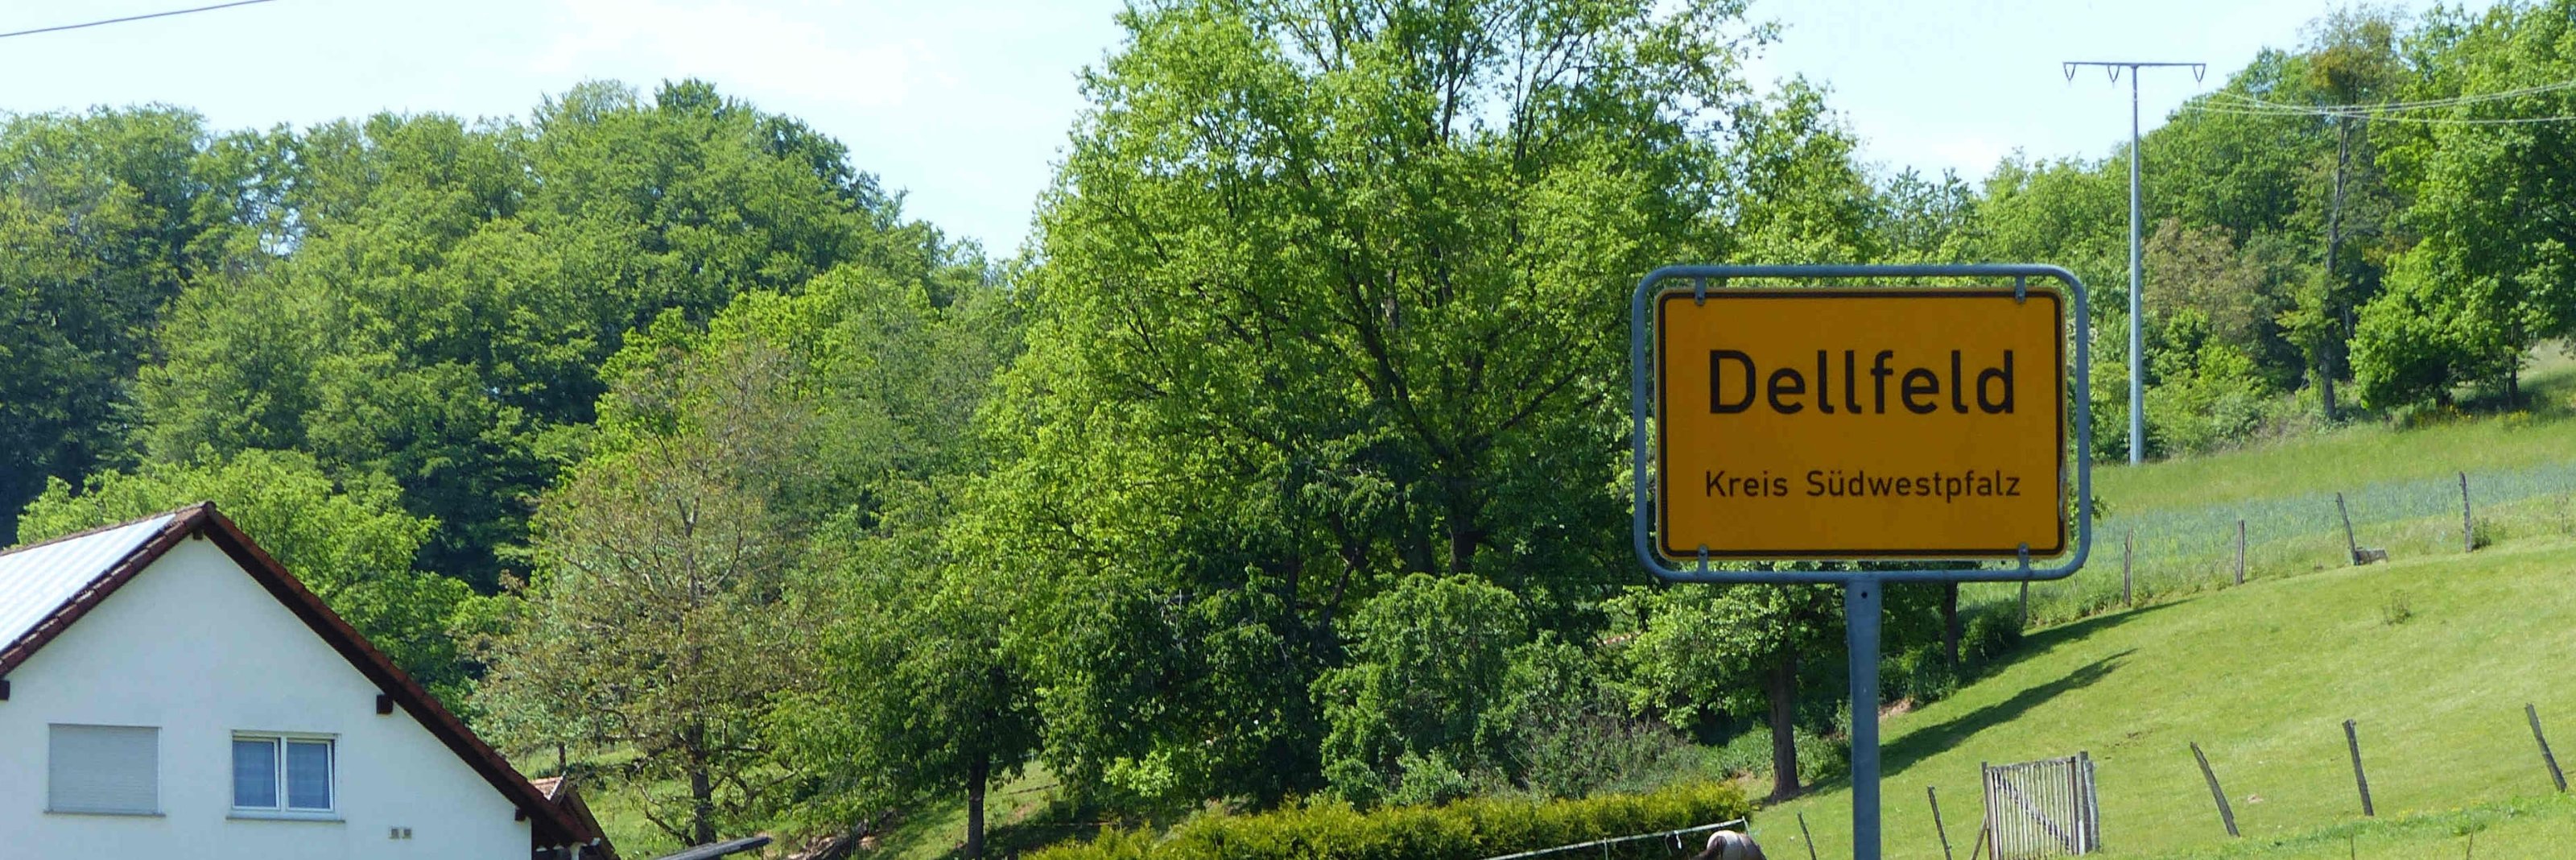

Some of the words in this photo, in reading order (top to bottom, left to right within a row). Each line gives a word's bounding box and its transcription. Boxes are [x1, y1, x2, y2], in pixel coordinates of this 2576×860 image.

[1709, 349, 2015, 415] Dellfeld
[1705, 469, 1789, 498] Kreis
[1806, 469, 2021, 503] Südwestpfalz
